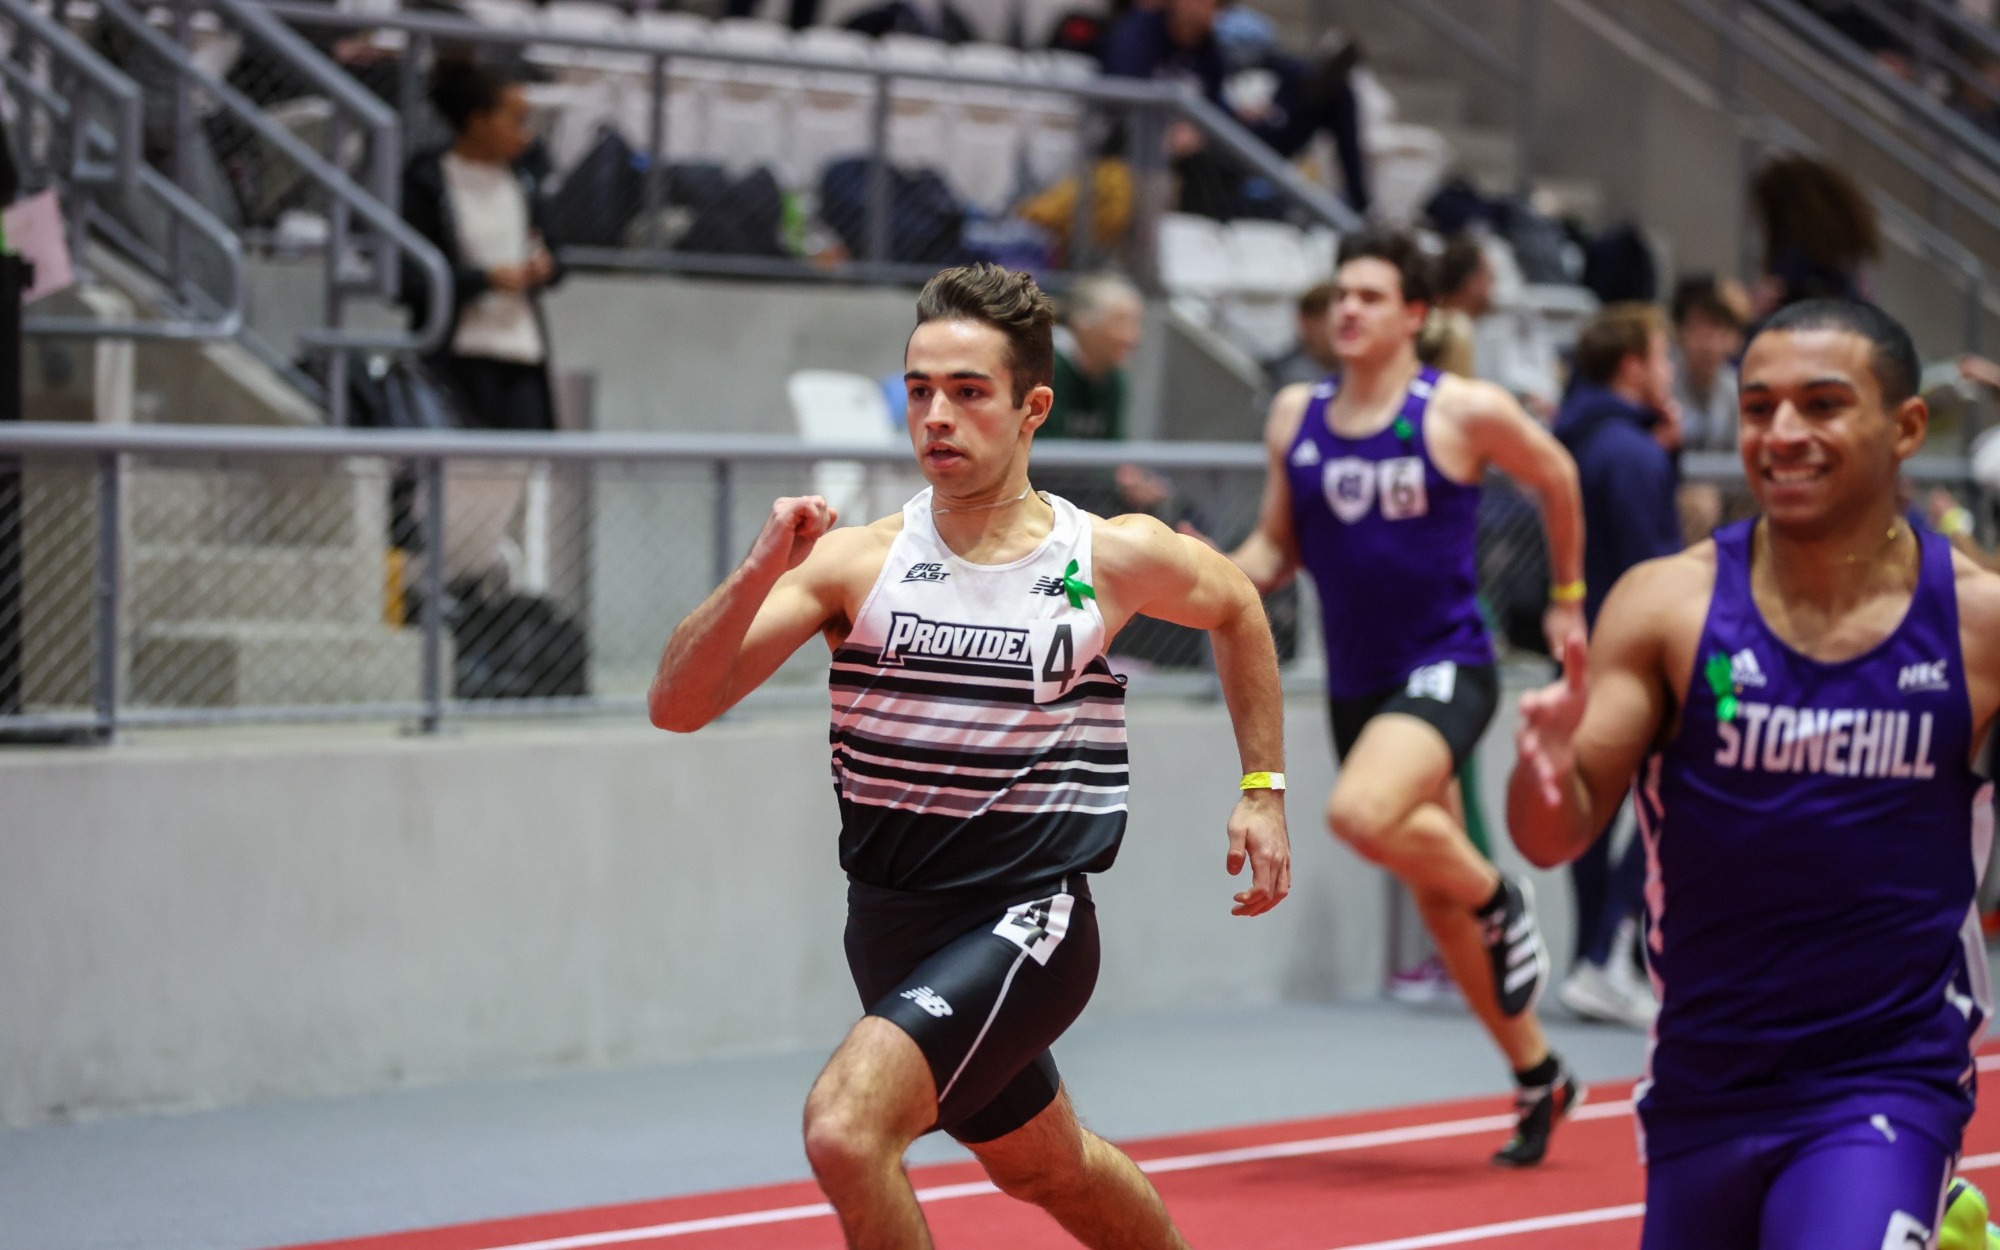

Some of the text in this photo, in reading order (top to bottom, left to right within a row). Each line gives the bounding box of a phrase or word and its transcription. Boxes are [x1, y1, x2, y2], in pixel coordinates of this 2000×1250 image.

[905, 570, 951, 580] EAST
[911, 563, 943, 571] BIG
[1042, 624, 1076, 694] 4
[1714, 702, 1936, 779] STONEHILL
